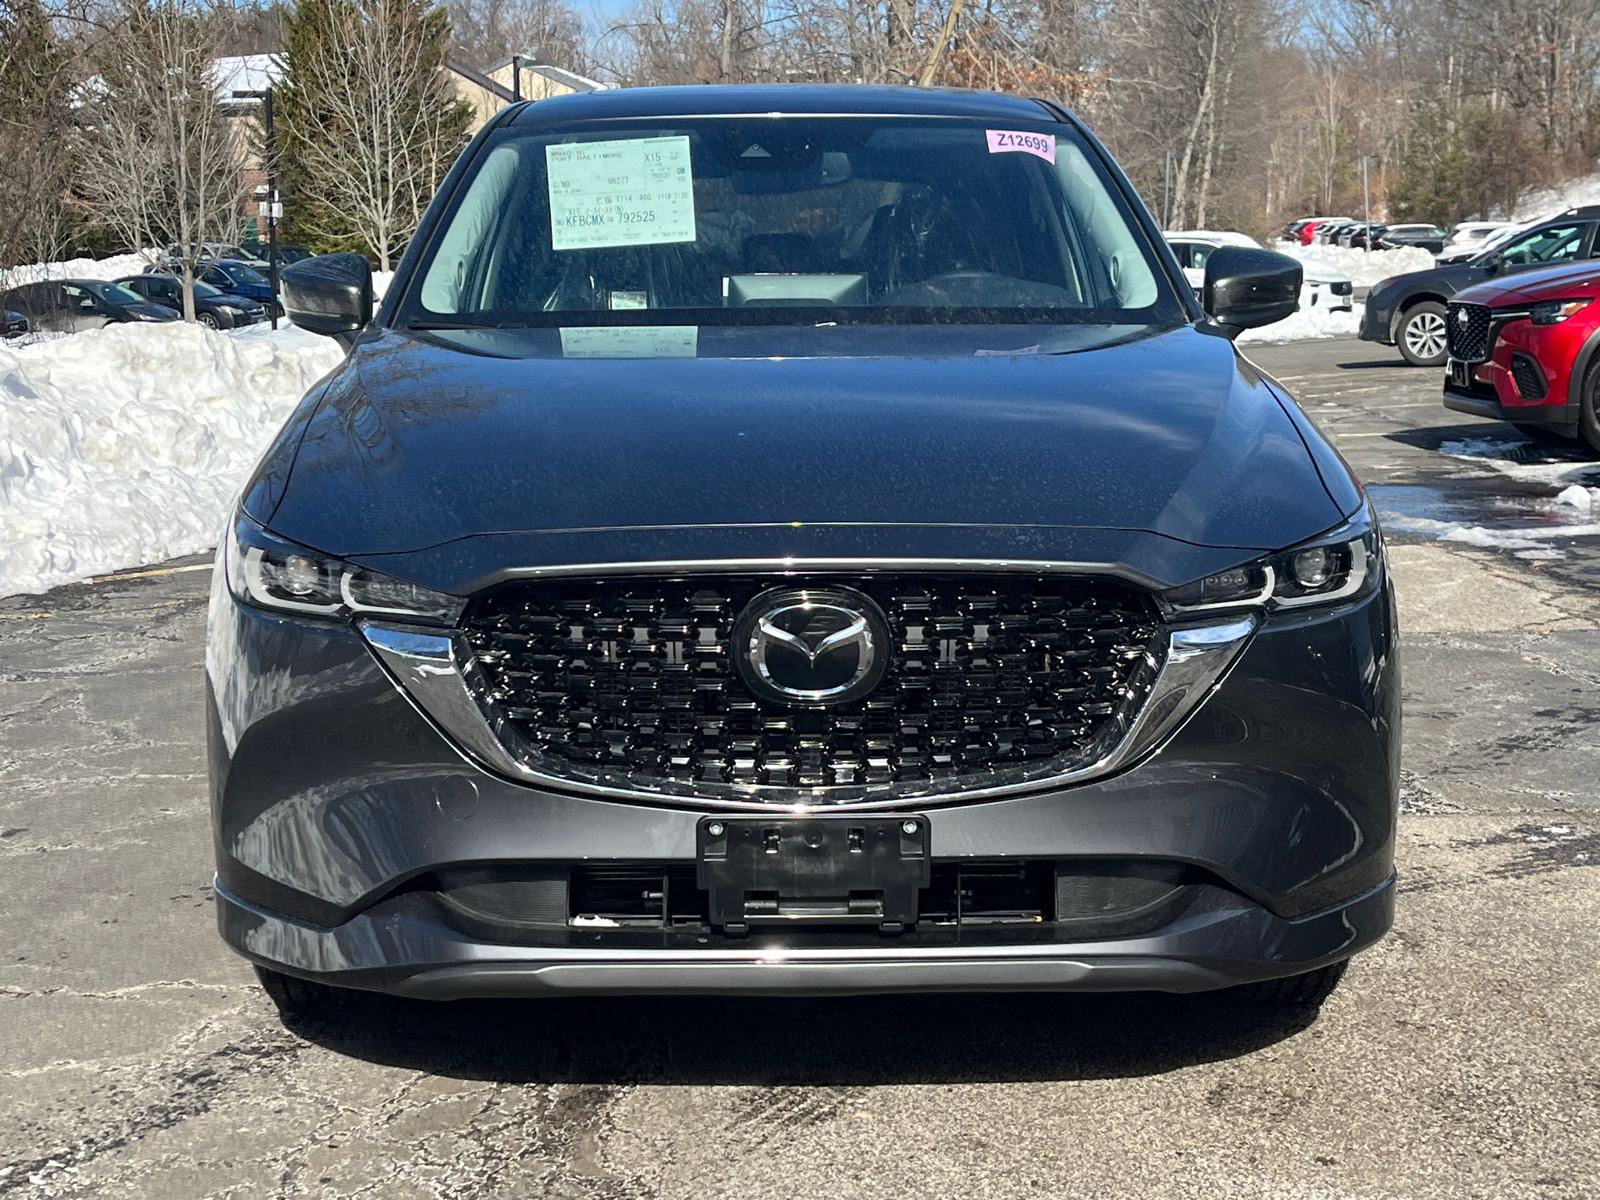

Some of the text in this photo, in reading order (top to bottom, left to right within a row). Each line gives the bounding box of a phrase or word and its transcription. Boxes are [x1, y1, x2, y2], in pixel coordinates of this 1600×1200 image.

[997, 133, 1048, 153] Z12699
[644, 152, 661, 163] X15
[566, 213, 605, 227] KFBCMX
[617, 211, 656, 224] 792525
